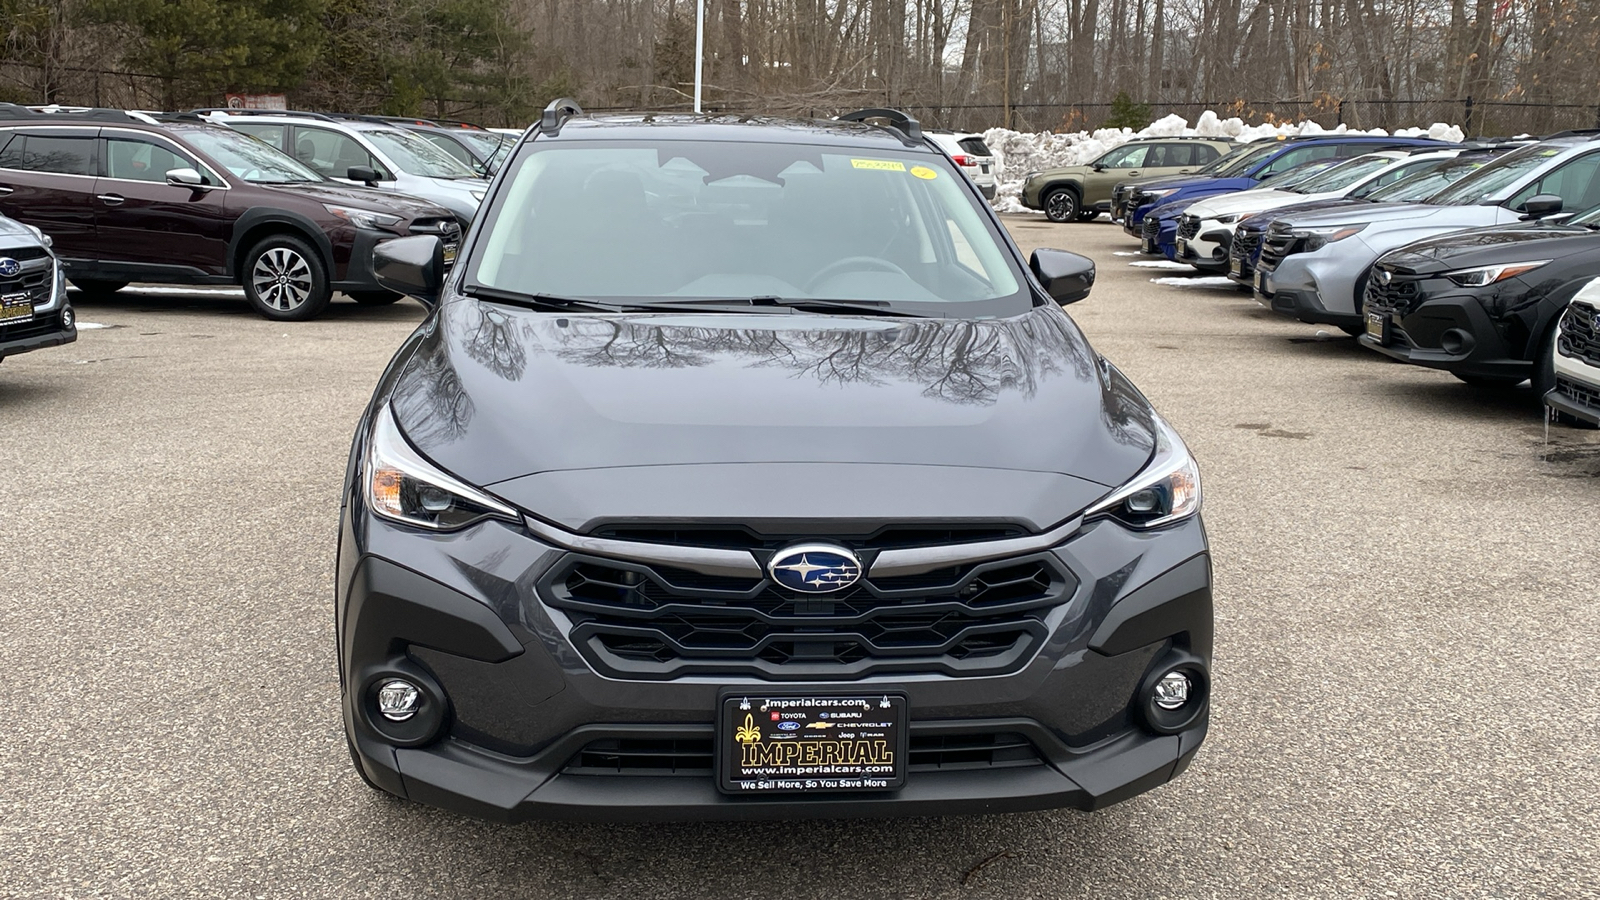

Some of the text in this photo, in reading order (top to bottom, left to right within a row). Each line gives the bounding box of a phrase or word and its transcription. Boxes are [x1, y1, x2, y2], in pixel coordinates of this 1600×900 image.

[764, 698, 866, 709] Imperialcars.com
[741, 740, 893, 766] IMPERIAL
[741, 764, 893, 775] www.imperialcars.com
[740, 779, 887, 789] We Sell More, So You Save More
